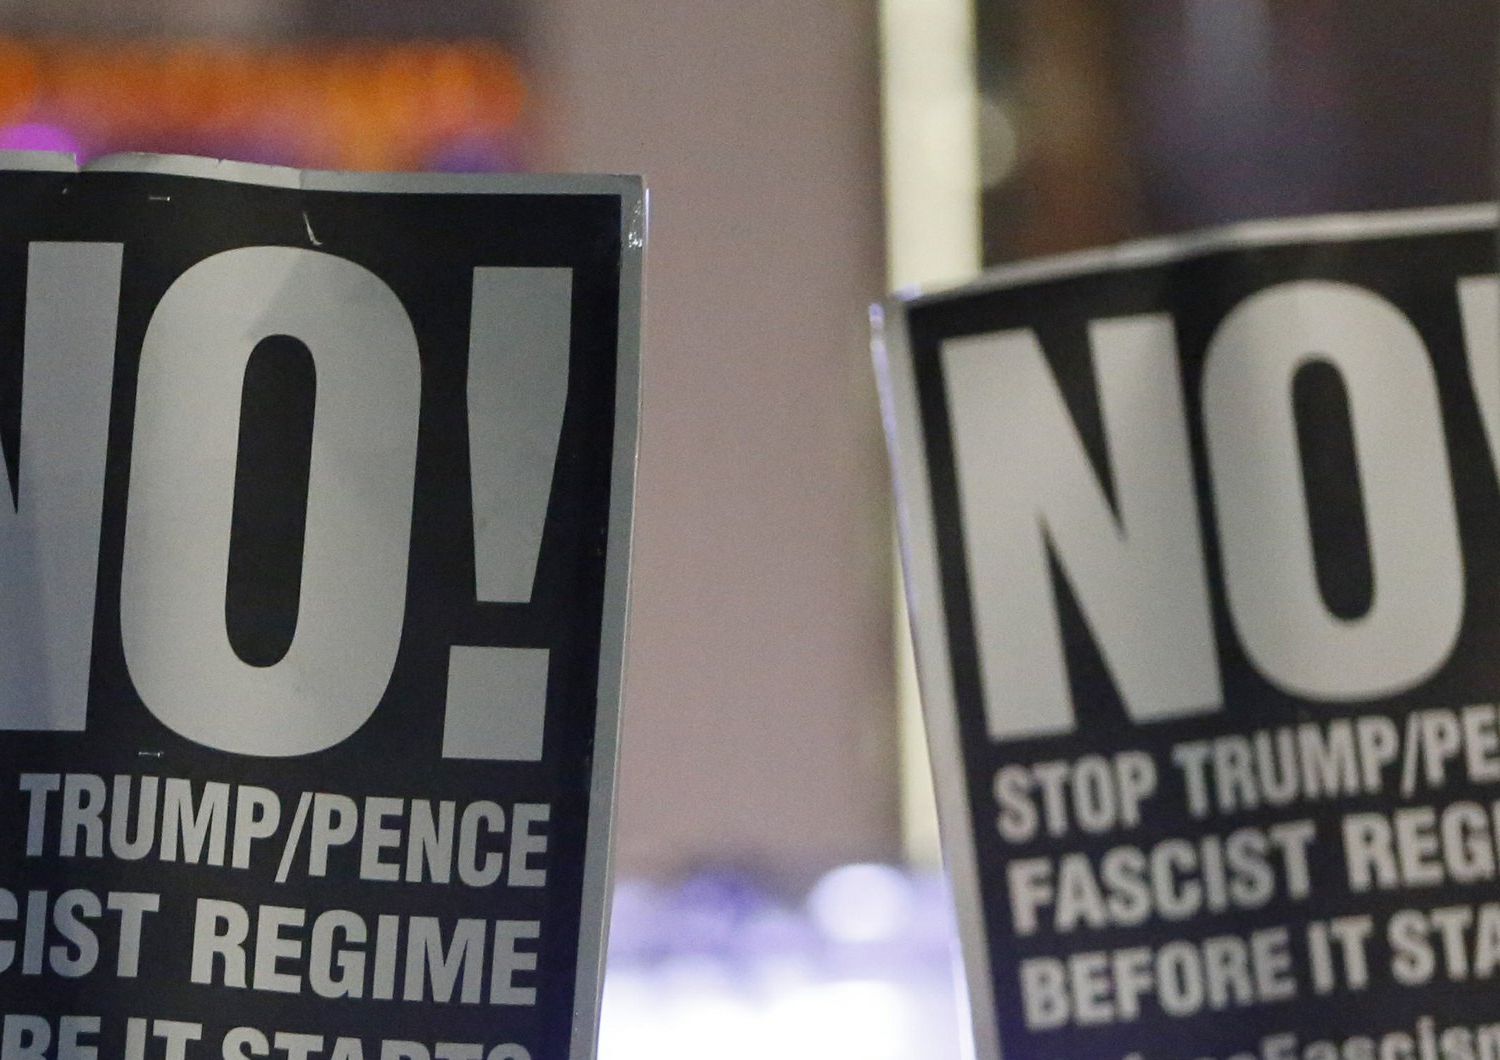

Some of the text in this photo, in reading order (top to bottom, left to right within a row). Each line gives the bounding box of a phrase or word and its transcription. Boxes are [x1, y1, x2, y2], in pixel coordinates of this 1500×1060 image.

[19, 772, 551, 887] TRUMP/PENCE
[993, 750, 1157, 844] STOP
[1006, 800, 1500, 936] FASCIST REG
[191, 898, 540, 1006] REGIME
[1018, 926, 1296, 1031] BEFORE
[1307, 915, 1373, 995] IT
